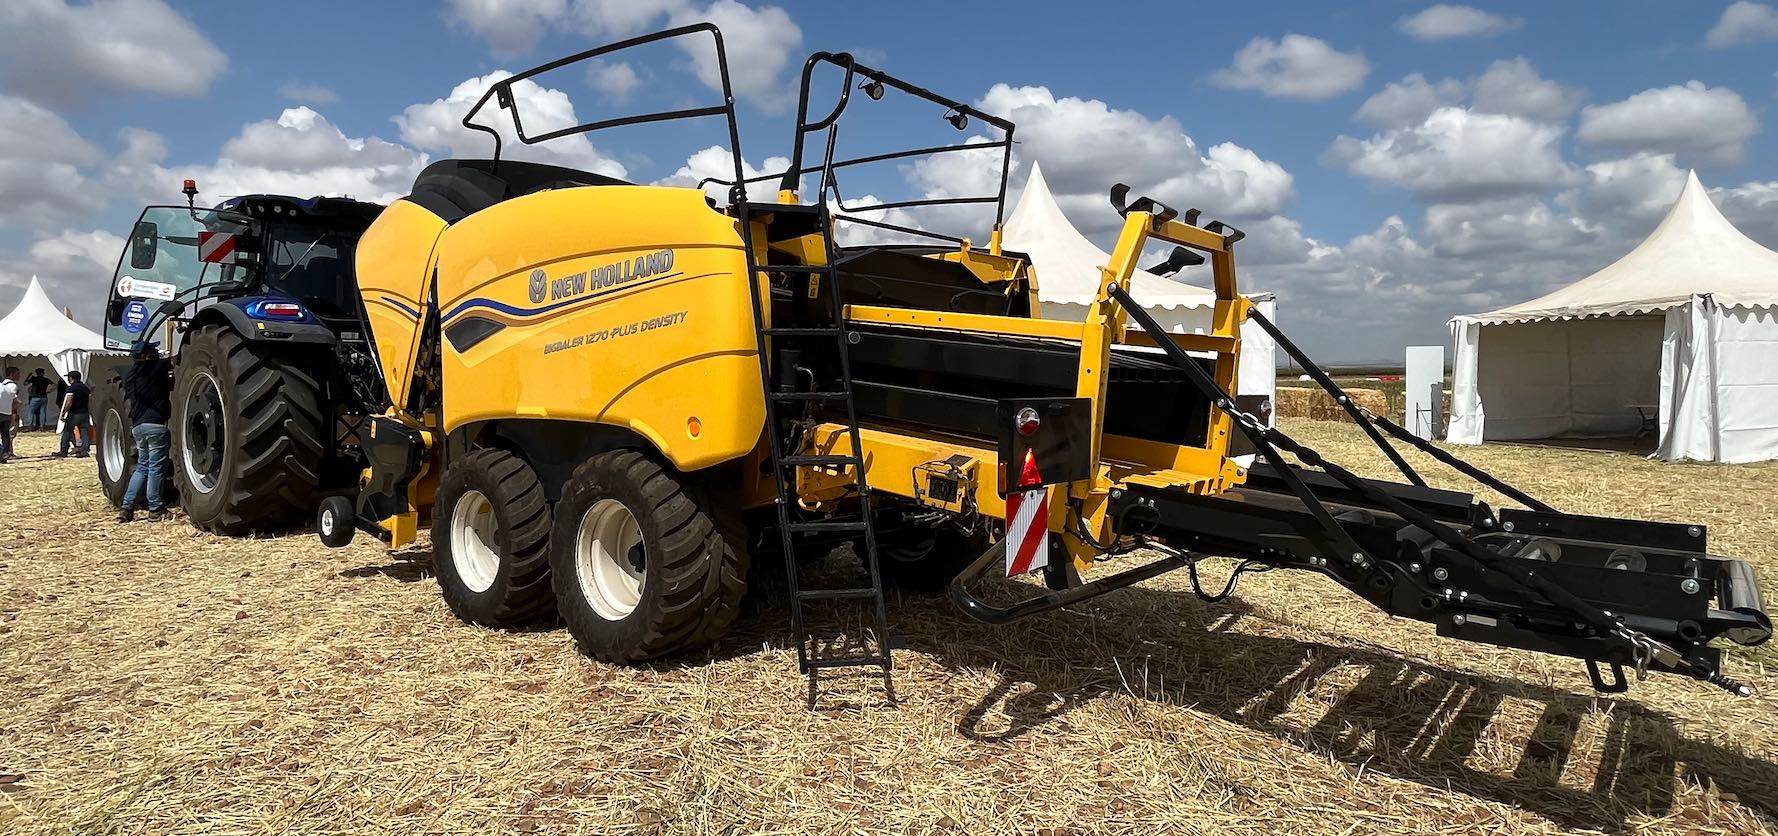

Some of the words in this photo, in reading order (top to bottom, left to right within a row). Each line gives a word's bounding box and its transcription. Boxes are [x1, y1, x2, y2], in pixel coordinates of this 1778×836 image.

[551, 271, 587, 301] NEW
[590, 249, 674, 290] HOLLAND
[544, 335, 584, 354] BIGBALER
[586, 330, 609, 344] 1270
[610, 322, 638, 338] PLUS
[640, 310, 689, 332] DENSITY
